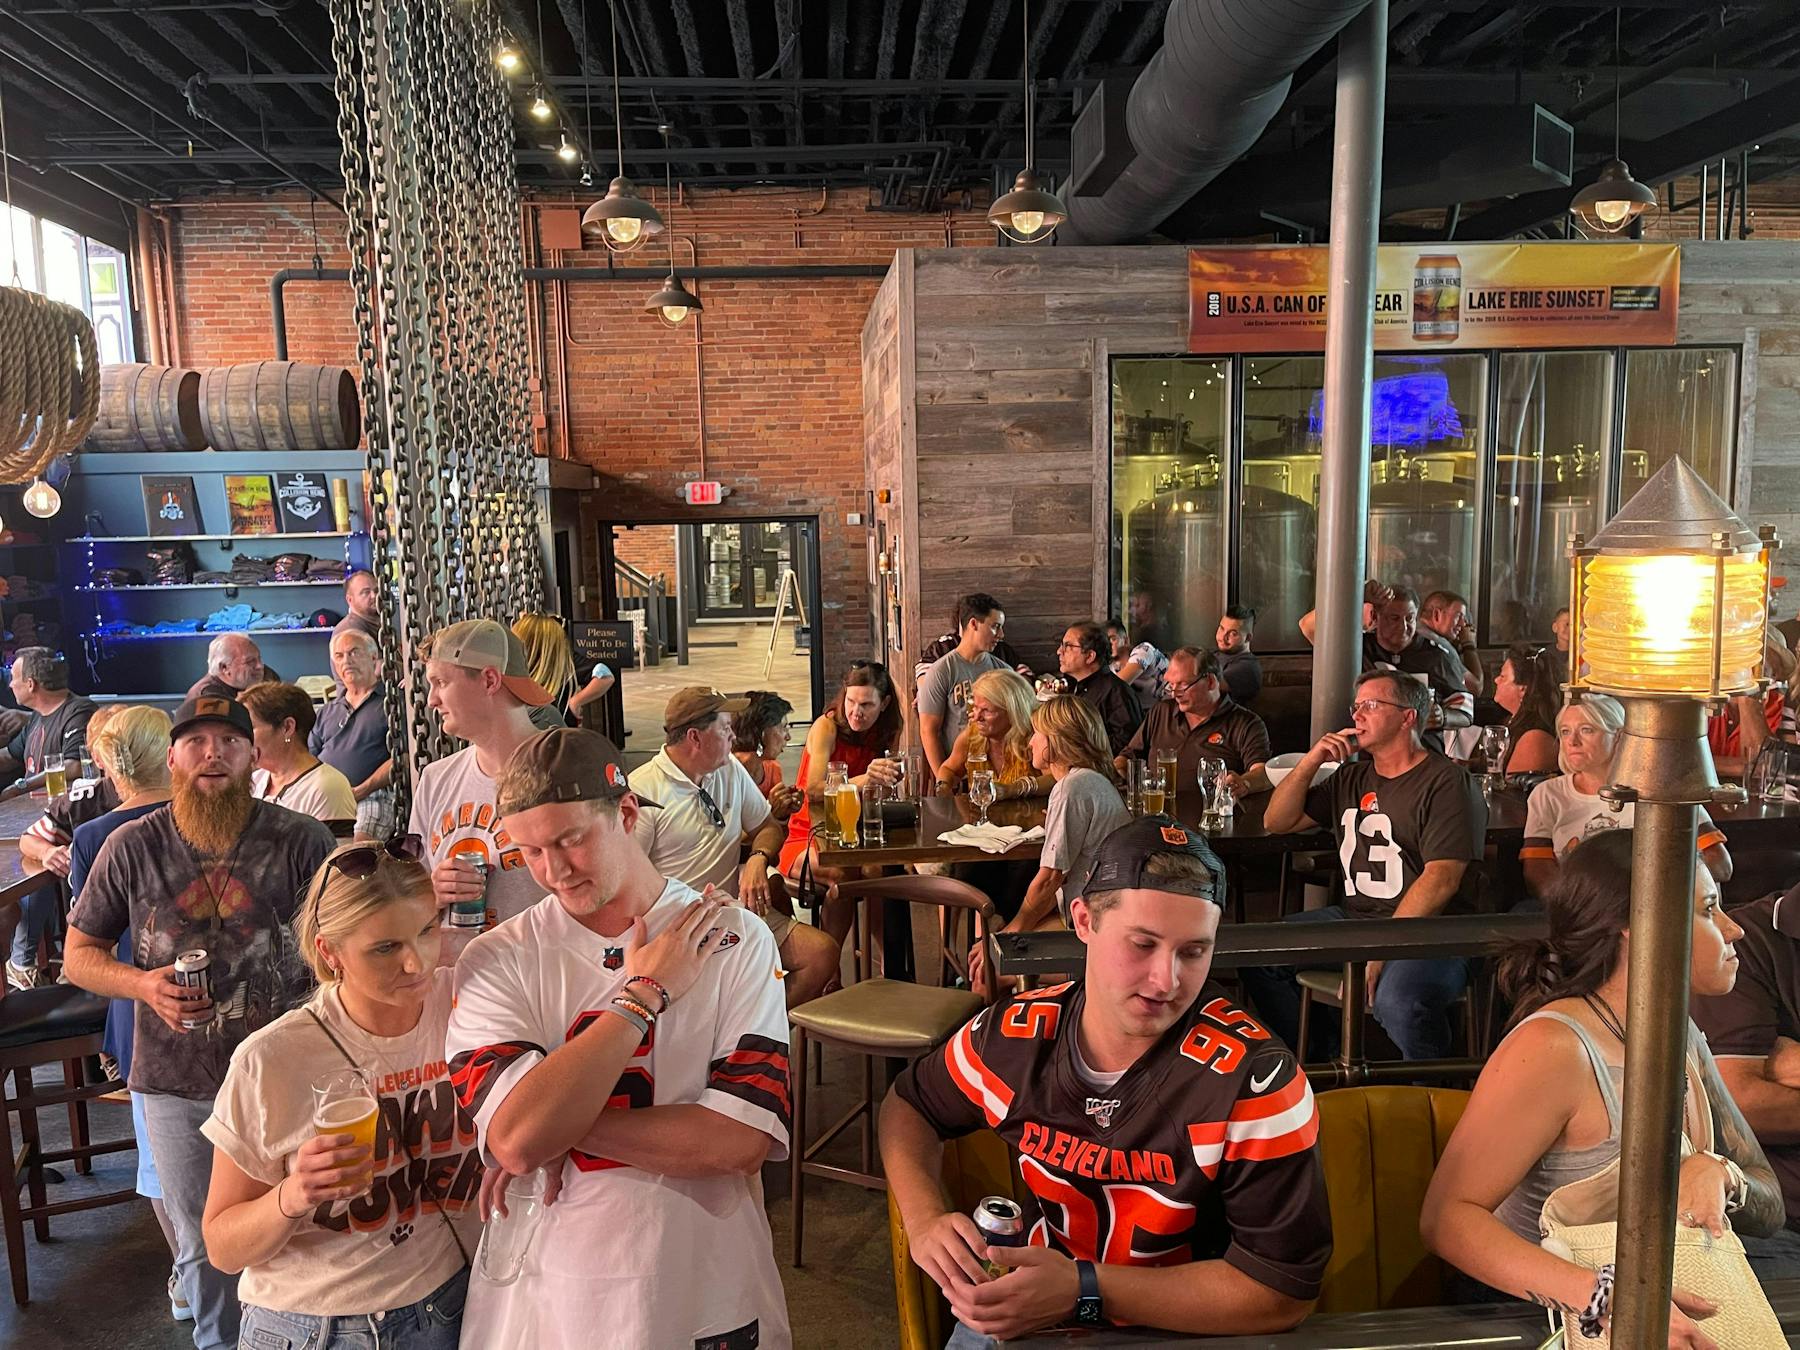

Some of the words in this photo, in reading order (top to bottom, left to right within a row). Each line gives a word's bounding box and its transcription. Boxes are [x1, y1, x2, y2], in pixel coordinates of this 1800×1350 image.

[1208, 294, 1220, 316] 2019
[1227, 295, 1270, 313] U.S.A.
[1273, 295, 1303, 313] CAN
[1307, 295, 1327, 313] OF
[1374, 293, 1402, 312] EAR
[1468, 291, 1506, 310] LAKE
[1509, 290, 1542, 309] ERIE
[1545, 289, 1606, 309] SUNSET
[691, 483, 716, 502] EXIT
[587, 628, 617, 637] Please
[576, 639, 597, 648] Wait
[600, 639, 612, 648] To
[615, 640, 627, 648] Be
[586, 650, 617, 659] Seated
[1340, 808, 1404, 899] 13
[1180, 997, 1272, 1075] 95
[1018, 1121, 1177, 1186] CLEVELAND
